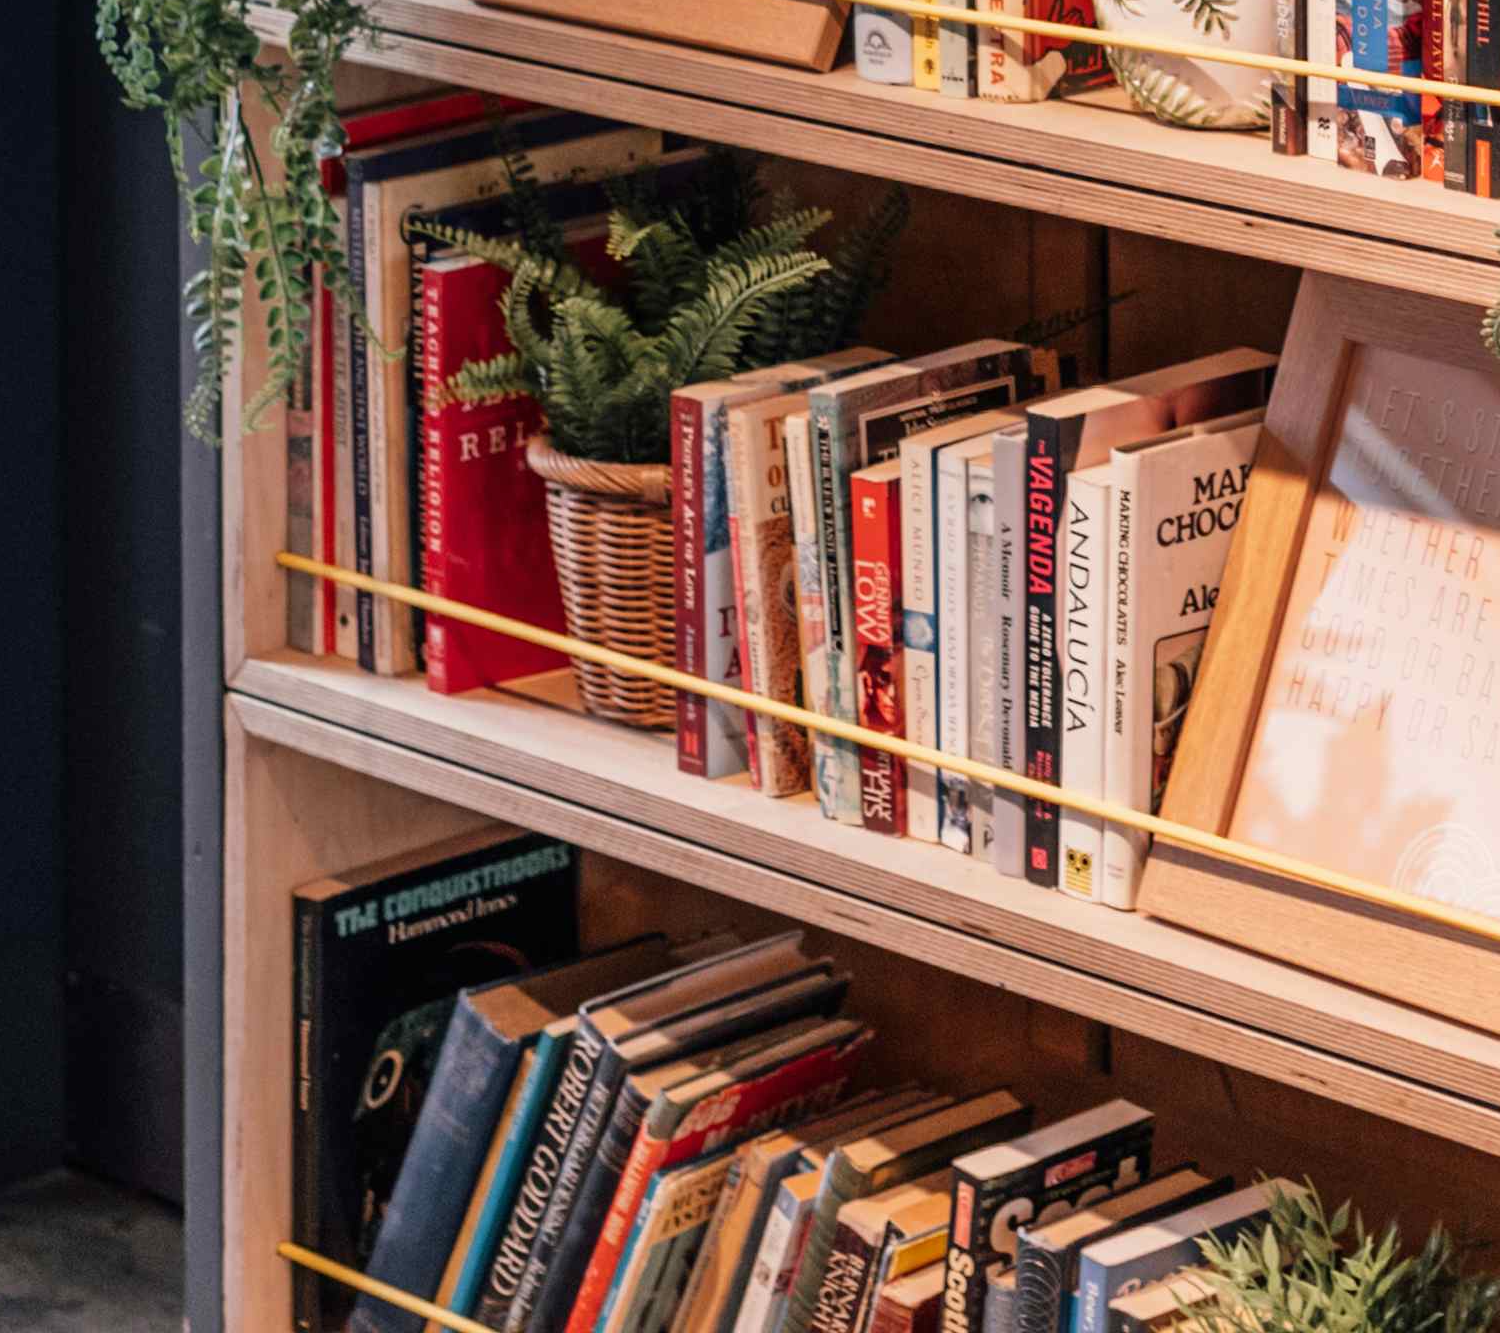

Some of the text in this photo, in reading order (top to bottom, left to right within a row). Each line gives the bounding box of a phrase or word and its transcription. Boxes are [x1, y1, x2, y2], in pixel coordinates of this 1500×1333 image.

[426, 430, 444, 554] RELIGION
[1028, 455, 1054, 595] VAGENDA
[854, 559, 876, 643] LOW
[1000, 538, 1012, 600] Memoir
[1066, 500, 1096, 733] ANDALUCÍA
[1116, 489, 1132, 646] MAKING CHOCOLATES
[1321, 550, 1493, 645] TIMES ARE
[1028, 606, 1039, 729] GUIDE TO THE MEDIA
[1041, 624, 1053, 730] ZERO TOLERANCE
[1285, 660, 1395, 732] HAPPY
[1404, 698, 1449, 747] OR
[1301, 606, 1387, 671] GOOD
[1400, 636, 1444, 688] OR
[543, 1040, 602, 1154] ROBERT
[489, 1143, 560, 1297] GODDARD
